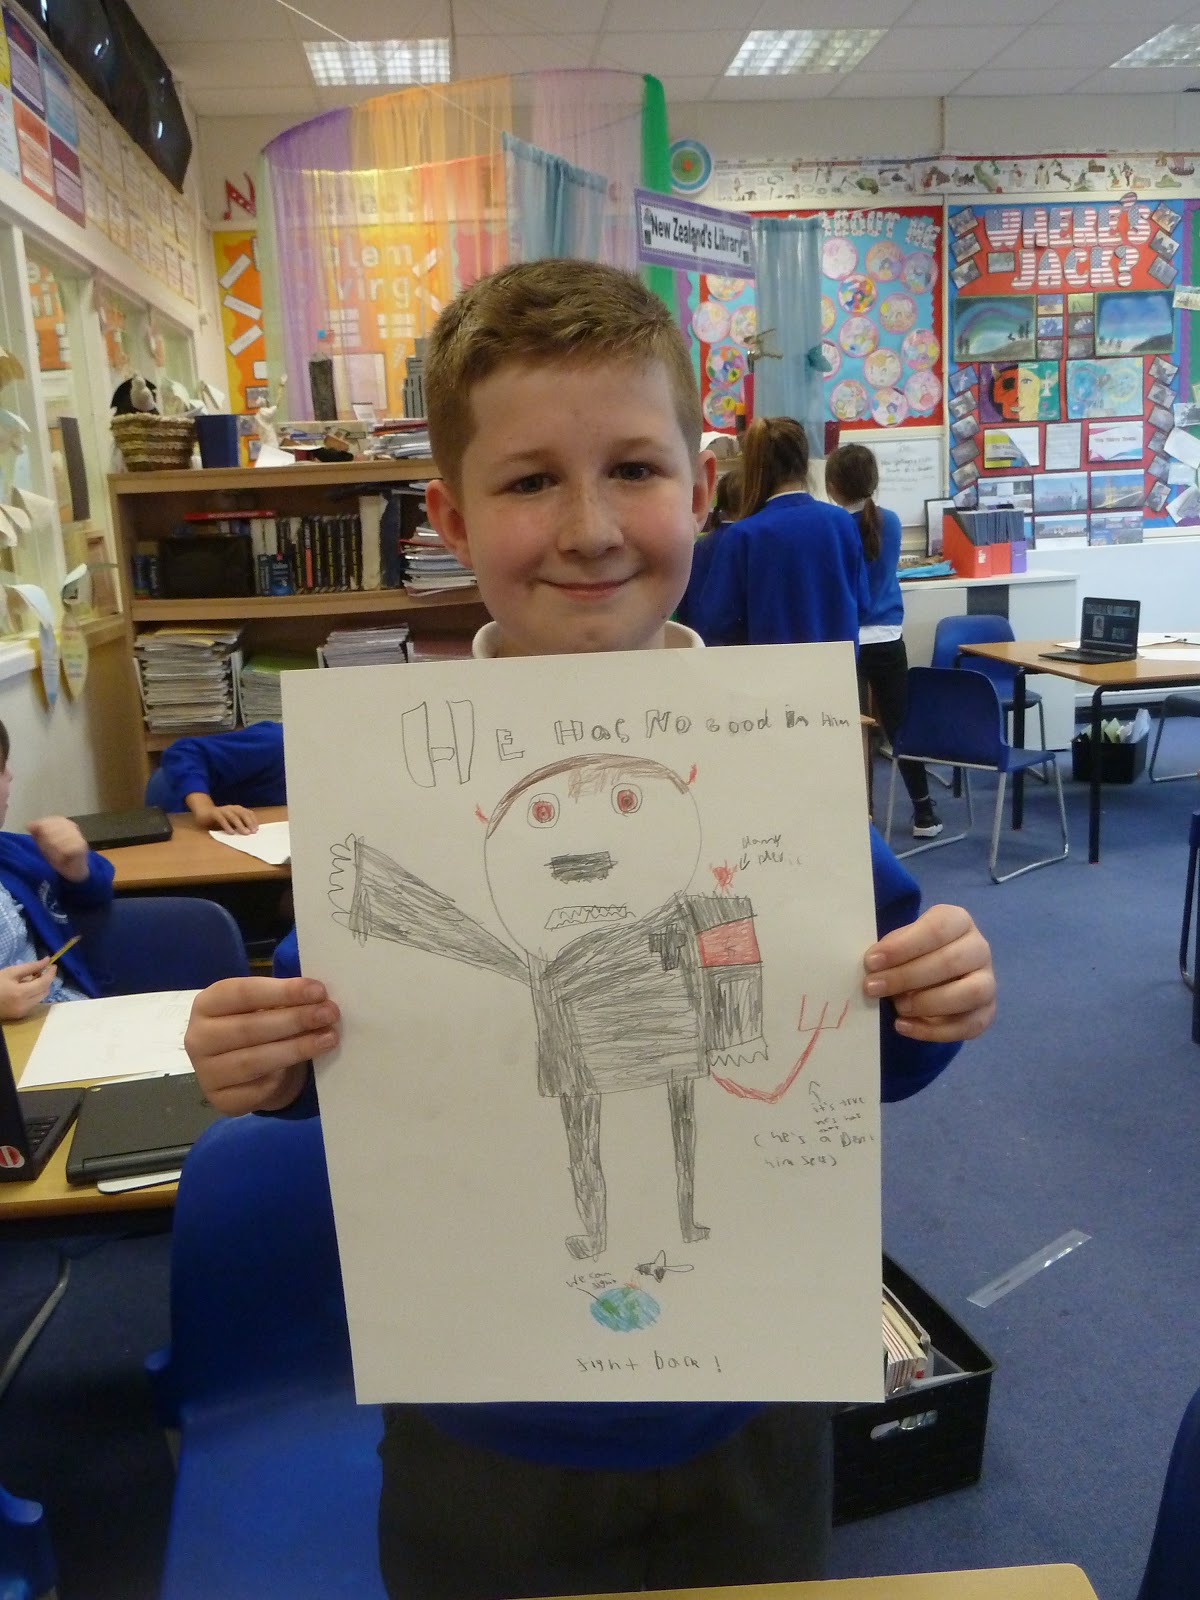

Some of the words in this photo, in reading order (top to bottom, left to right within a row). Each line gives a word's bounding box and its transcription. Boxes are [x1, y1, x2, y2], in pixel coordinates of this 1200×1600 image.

[651, 213, 671, 240] New
[673, 217, 712, 250] Zealand's
[714, 226, 741, 259] Library
[985, 192, 1152, 249] WHERE'S
[1011, 245, 1140, 290] JACK?
[819, 1135, 832, 1143] a
